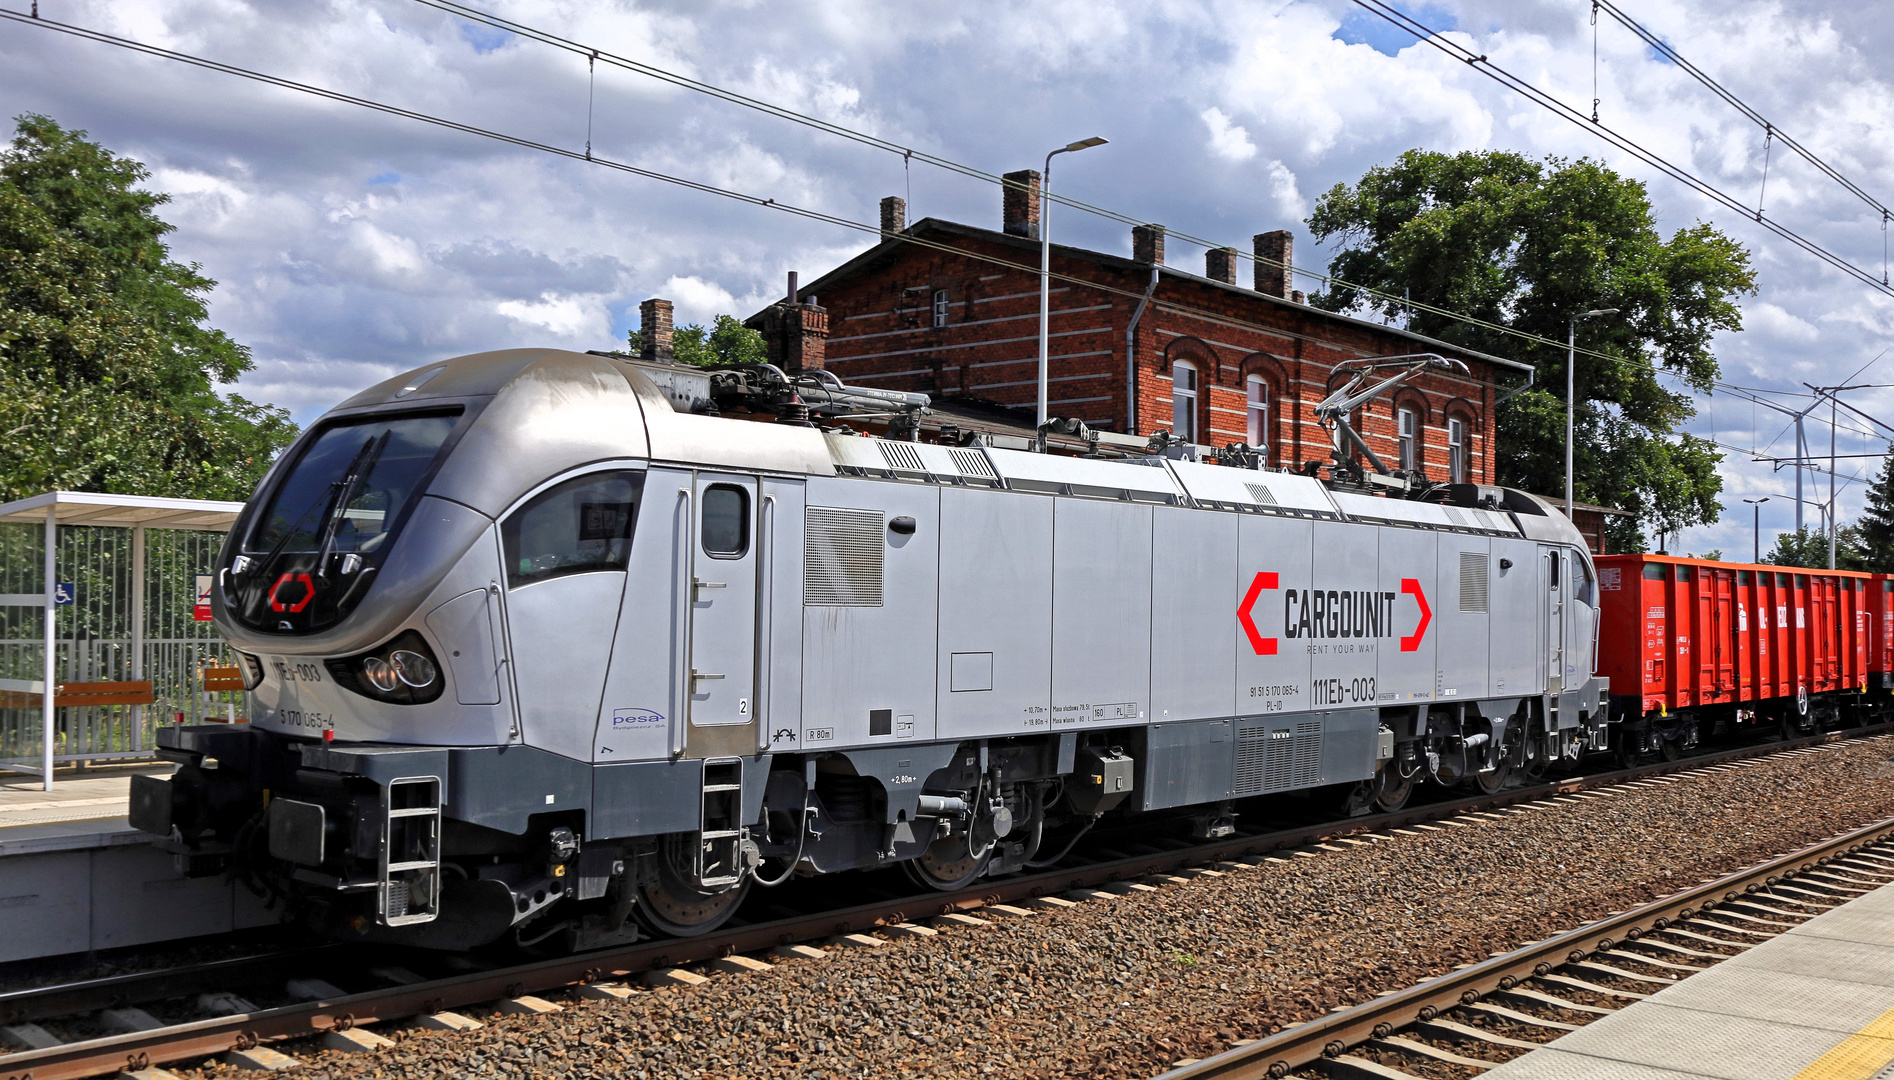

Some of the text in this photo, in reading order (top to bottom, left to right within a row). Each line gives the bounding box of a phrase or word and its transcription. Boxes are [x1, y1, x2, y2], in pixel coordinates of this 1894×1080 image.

[1284, 588, 1396, 639] CARGOUNIT
[1306, 644, 1375, 654] RENT YOUR WAY
[1250, 685, 1299, 697] 91 51 5 170 065-4
[1313, 677, 1376, 705] 111Eb-003
[740, 700, 747, 714] 2
[1266, 700, 1283, 711] PL-ID
[1094, 708, 1104, 718] 160
[1116, 707, 1123, 716] PL
[280, 709, 335, 729] 5 170 065-4
[613, 715, 660, 726] pesa
[810, 730, 831, 740] R 80m
[895, 775, 913, 784] 2,80m
